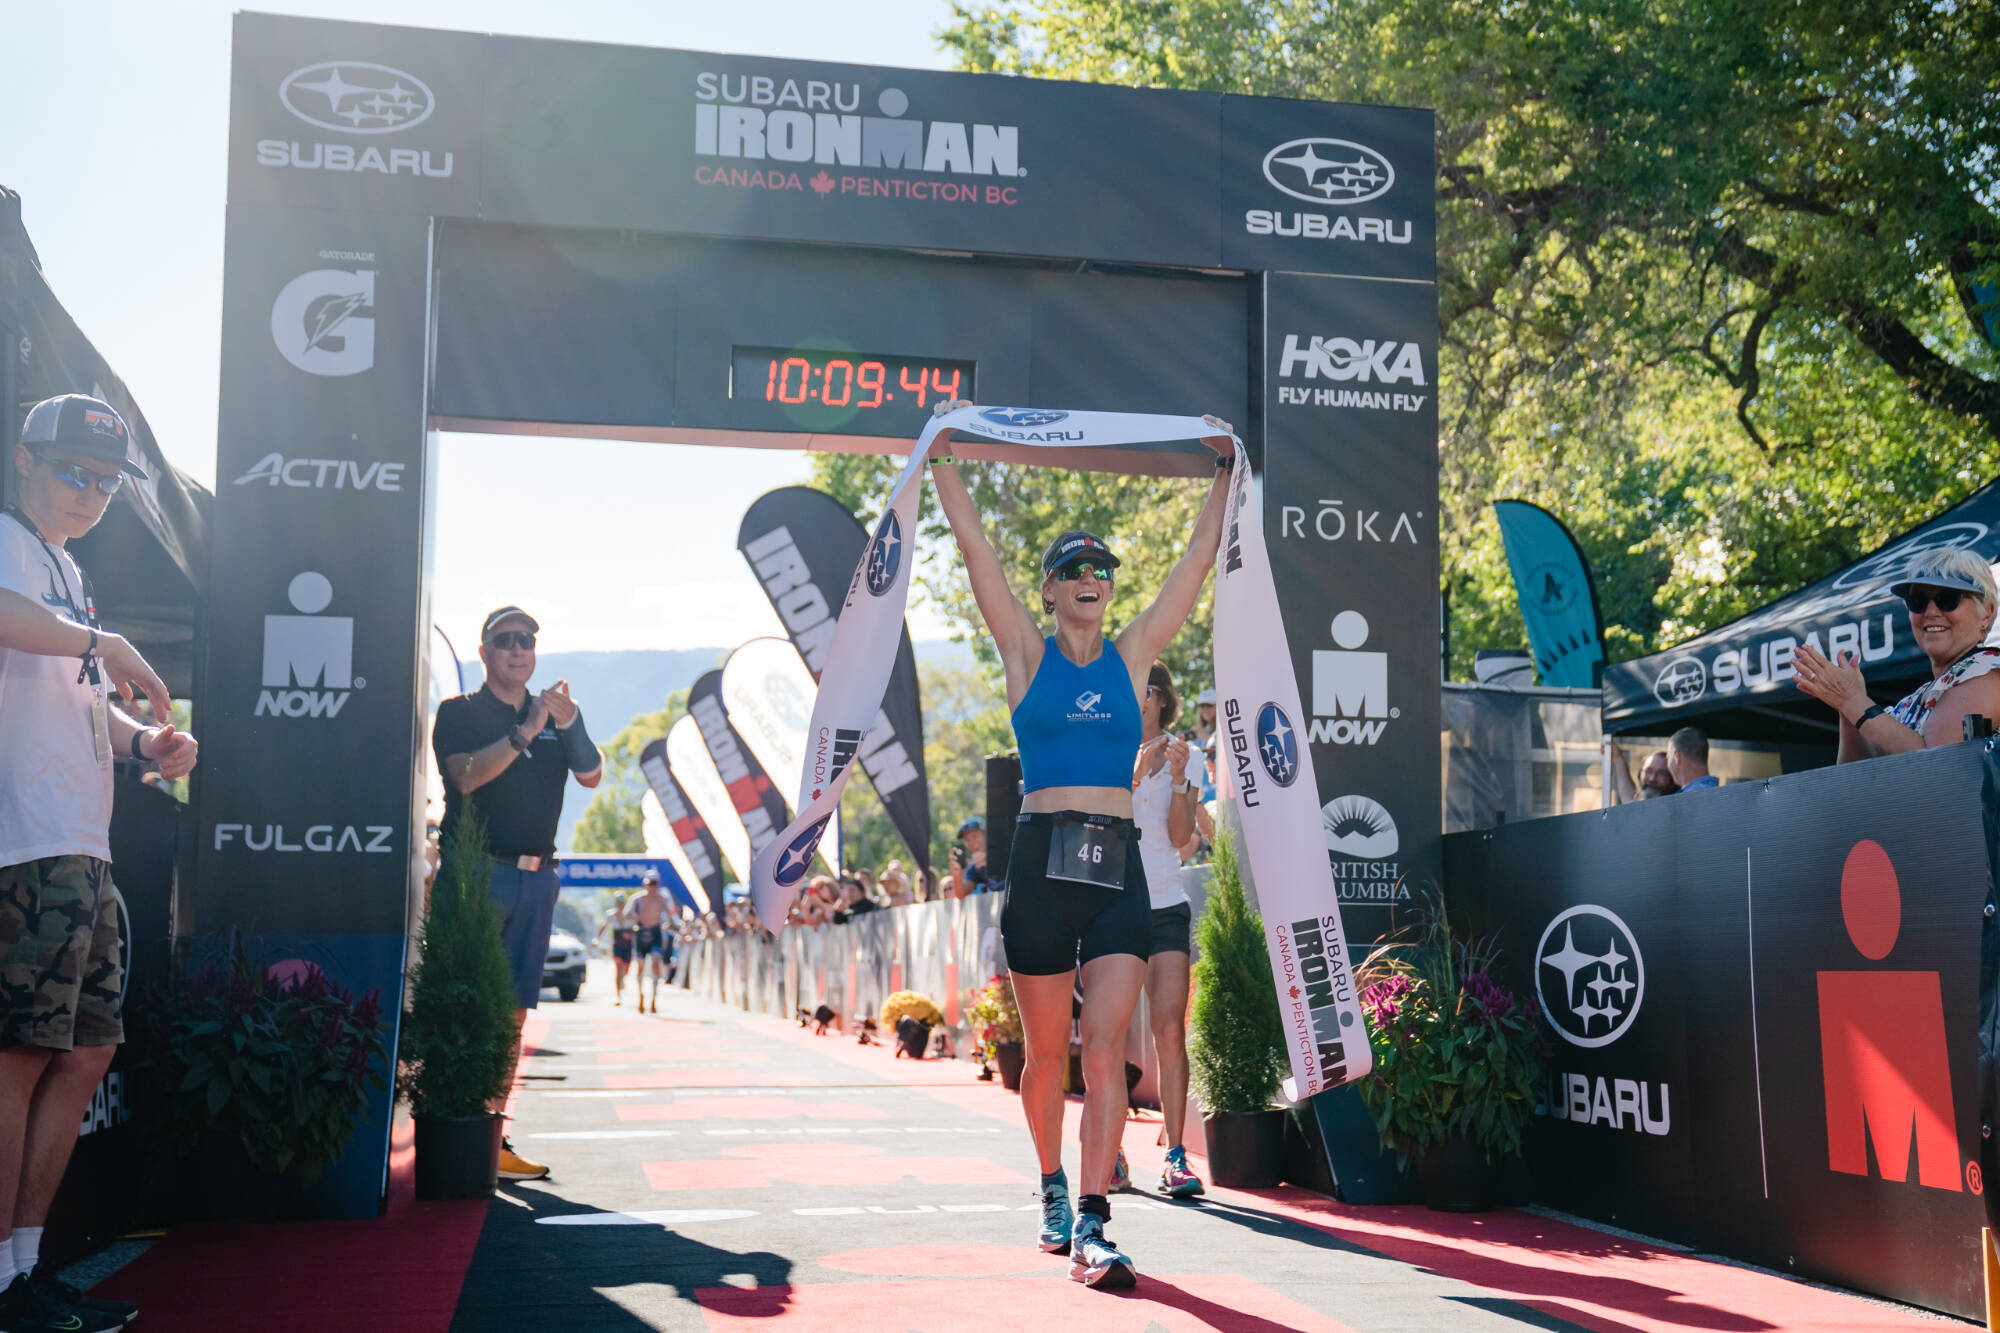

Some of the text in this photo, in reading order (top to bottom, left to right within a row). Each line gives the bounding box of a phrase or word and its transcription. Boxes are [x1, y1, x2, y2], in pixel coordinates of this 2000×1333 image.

[696, 72, 860, 112] SUBARU
[256, 139, 454, 178] SUBARU
[695, 166, 1018, 205] CANADA PENTICTON BC
[1245, 209, 1413, 244] SUBARU
[319, 250, 376, 262] GATORADE
[1279, 334, 1425, 387] HOKA
[1278, 386, 1425, 412] FLY HUMAN FLY
[969, 422, 1084, 442] SUBARU
[232, 452, 406, 492] ACTIVE
[254, 690, 350, 718] NOW
[1309, 719, 1388, 746] NOW
[813, 726, 830, 785] CANADA
[1225, 698, 1260, 808] SUBARU
[213, 823, 394, 853] FULGAZ
[1077, 843, 1103, 864] 46
[1330, 861, 1399, 879] RITISH
[1337, 881, 1411, 900] UMBIA
[1322, 915, 1351, 1003] SUBARU
[1275, 924, 1297, 983] CANADA
[1291, 1001, 1317, 1077] PENTICTON
[1291, 917, 1349, 1091] IRONMAN
